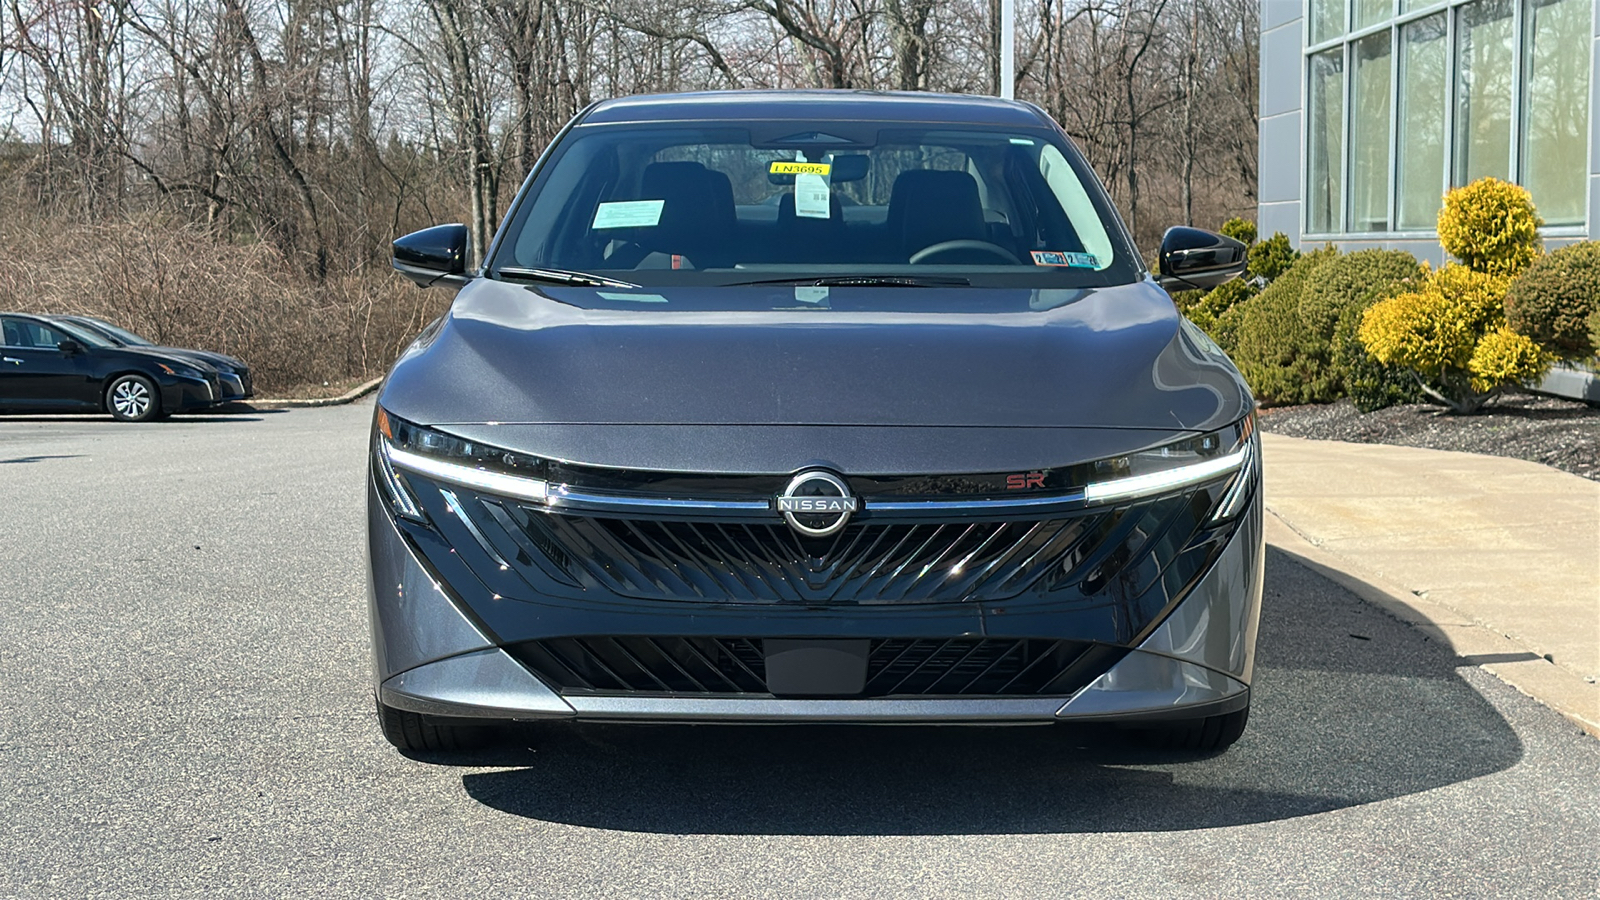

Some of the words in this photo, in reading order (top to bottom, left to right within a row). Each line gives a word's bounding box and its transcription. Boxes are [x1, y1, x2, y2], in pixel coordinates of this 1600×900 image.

[774, 165, 823, 174] LN3695
[1006, 473, 1045, 489] SR
[780, 500, 855, 510] NISSAN
